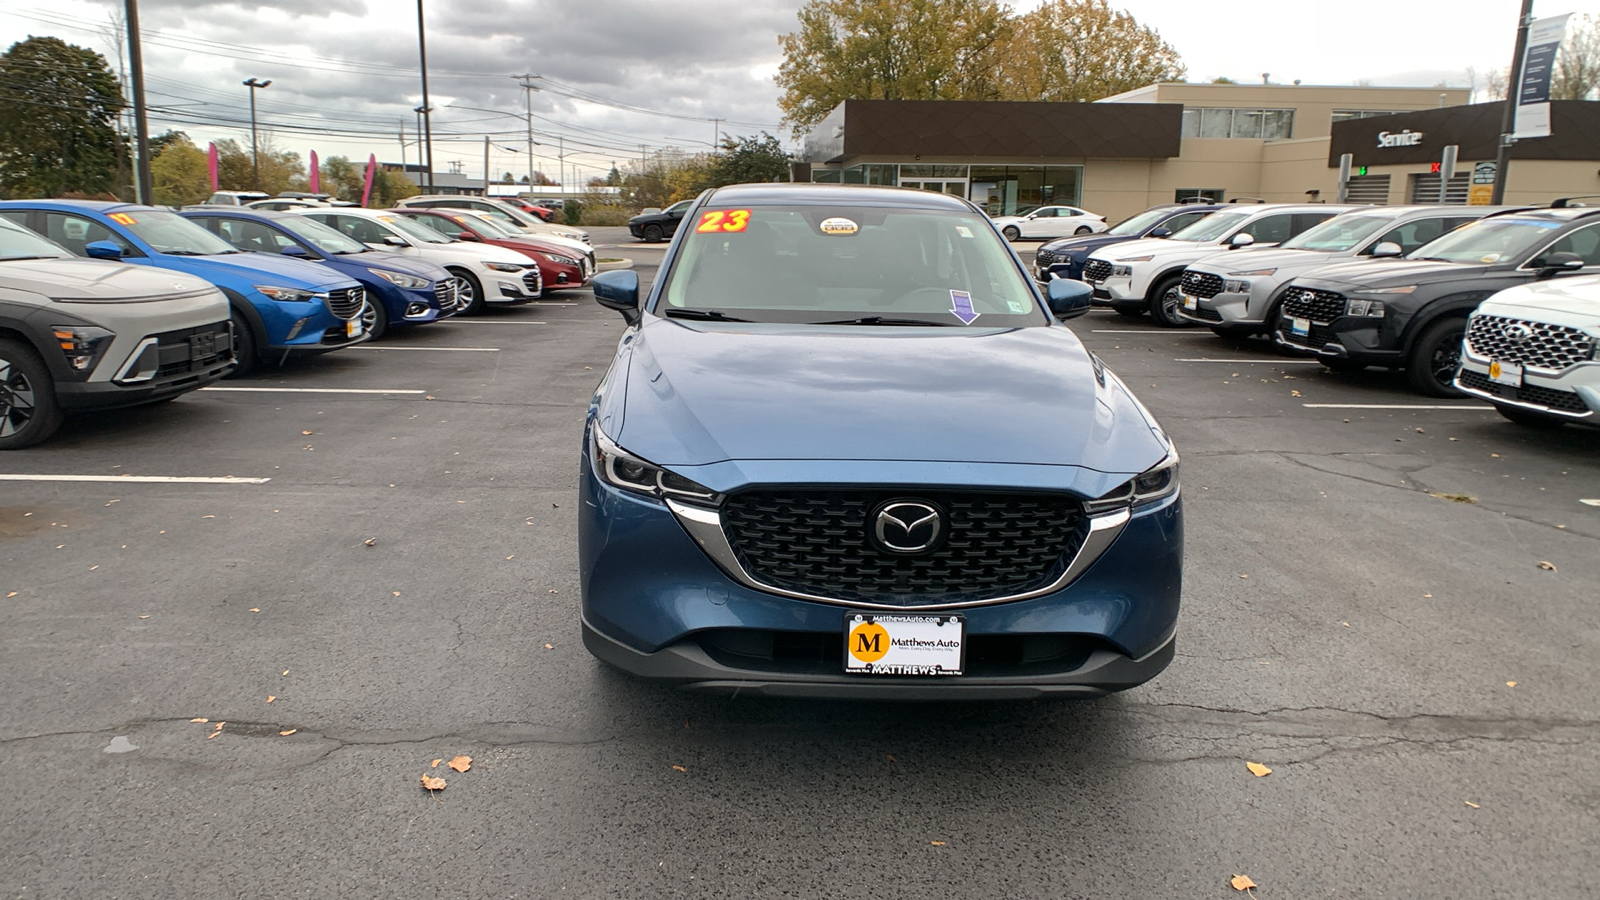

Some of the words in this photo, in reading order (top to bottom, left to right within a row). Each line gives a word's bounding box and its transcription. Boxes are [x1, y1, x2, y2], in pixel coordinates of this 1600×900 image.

[1377, 129, 1422, 147] Service
[110, 213, 137, 224] 17
[698, 210, 749, 232] 23
[872, 615, 940, 623] MatthewsAuto.com
[856, 633, 882, 652] M
[891, 637, 935, 647] Matthews
[936, 639, 960, 648] Auto
[872, 664, 937, 675] MATTHEWS
